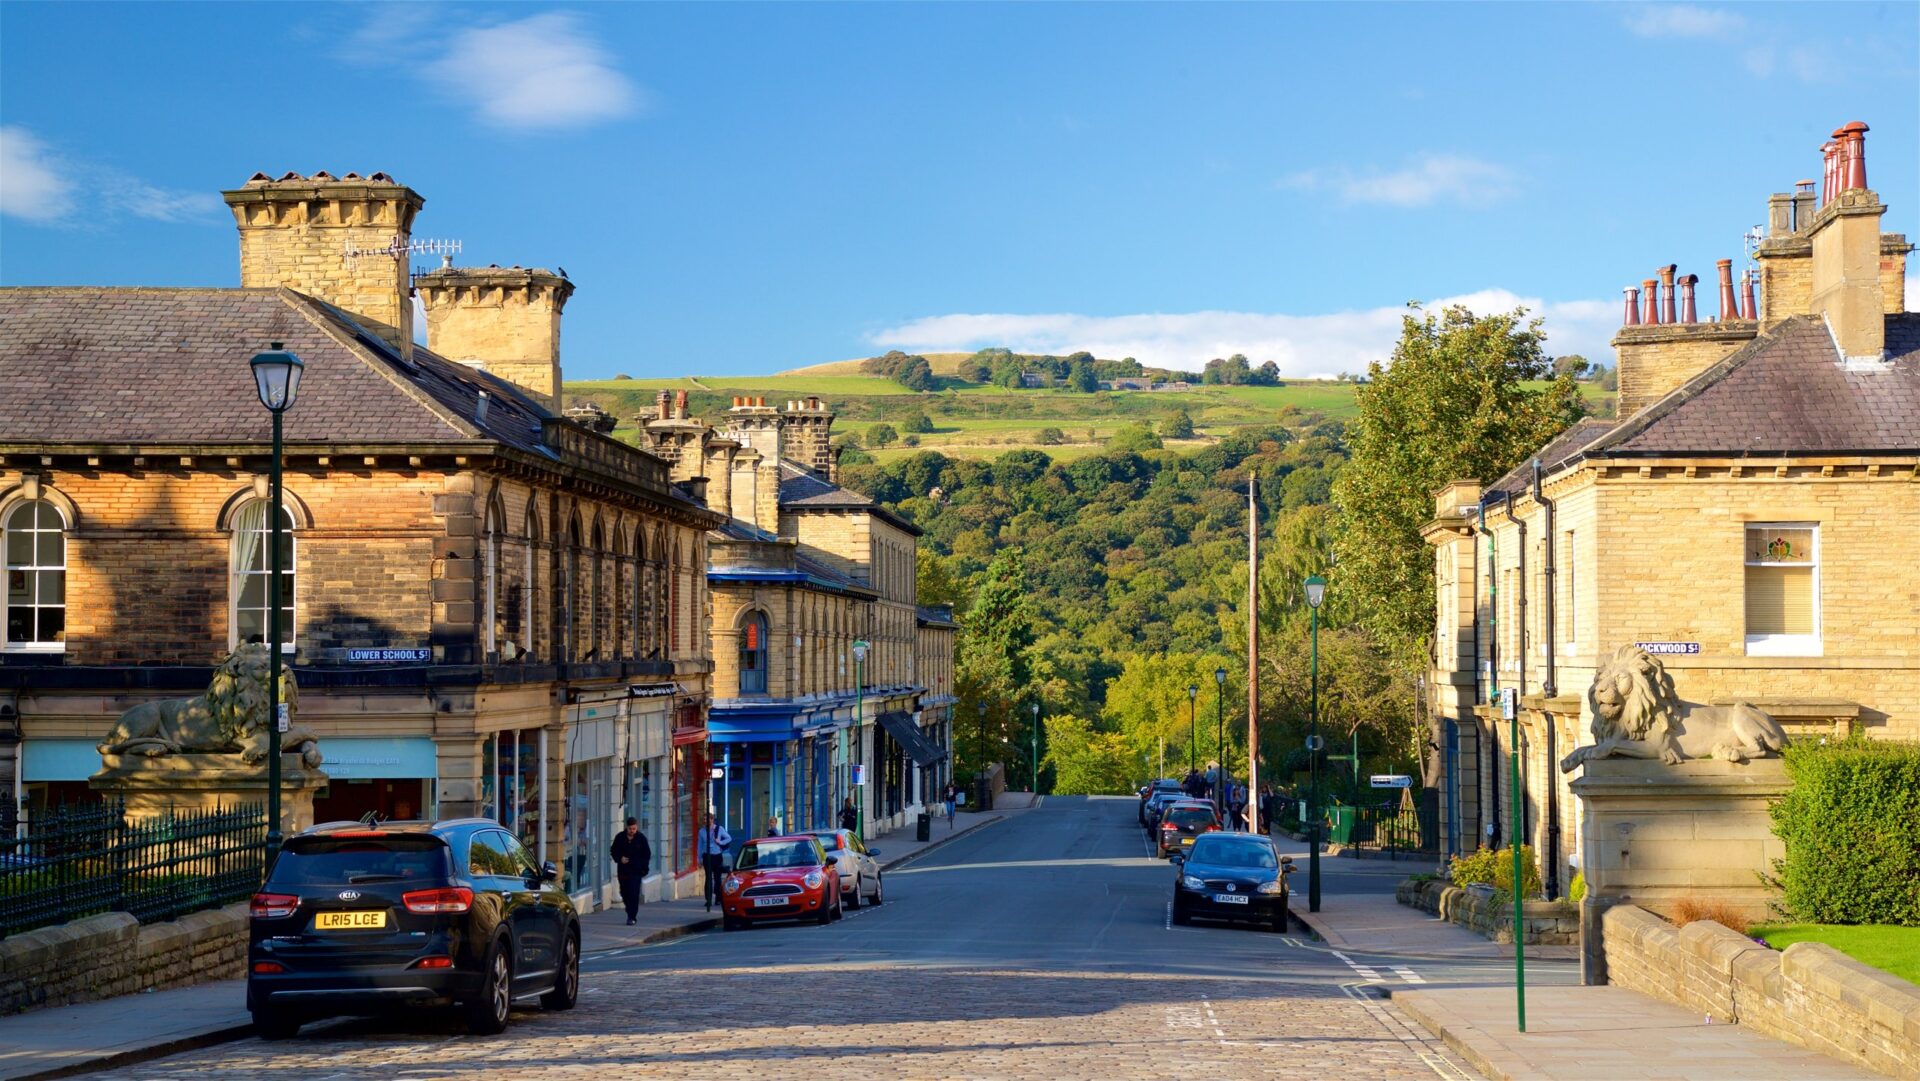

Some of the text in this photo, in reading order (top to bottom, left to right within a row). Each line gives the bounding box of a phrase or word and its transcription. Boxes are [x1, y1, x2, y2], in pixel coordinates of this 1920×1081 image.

[350, 650, 380, 660] LOWER
[382, 650, 417, 660] SCHOOL
[323, 913, 379, 927] LR15 LGE
